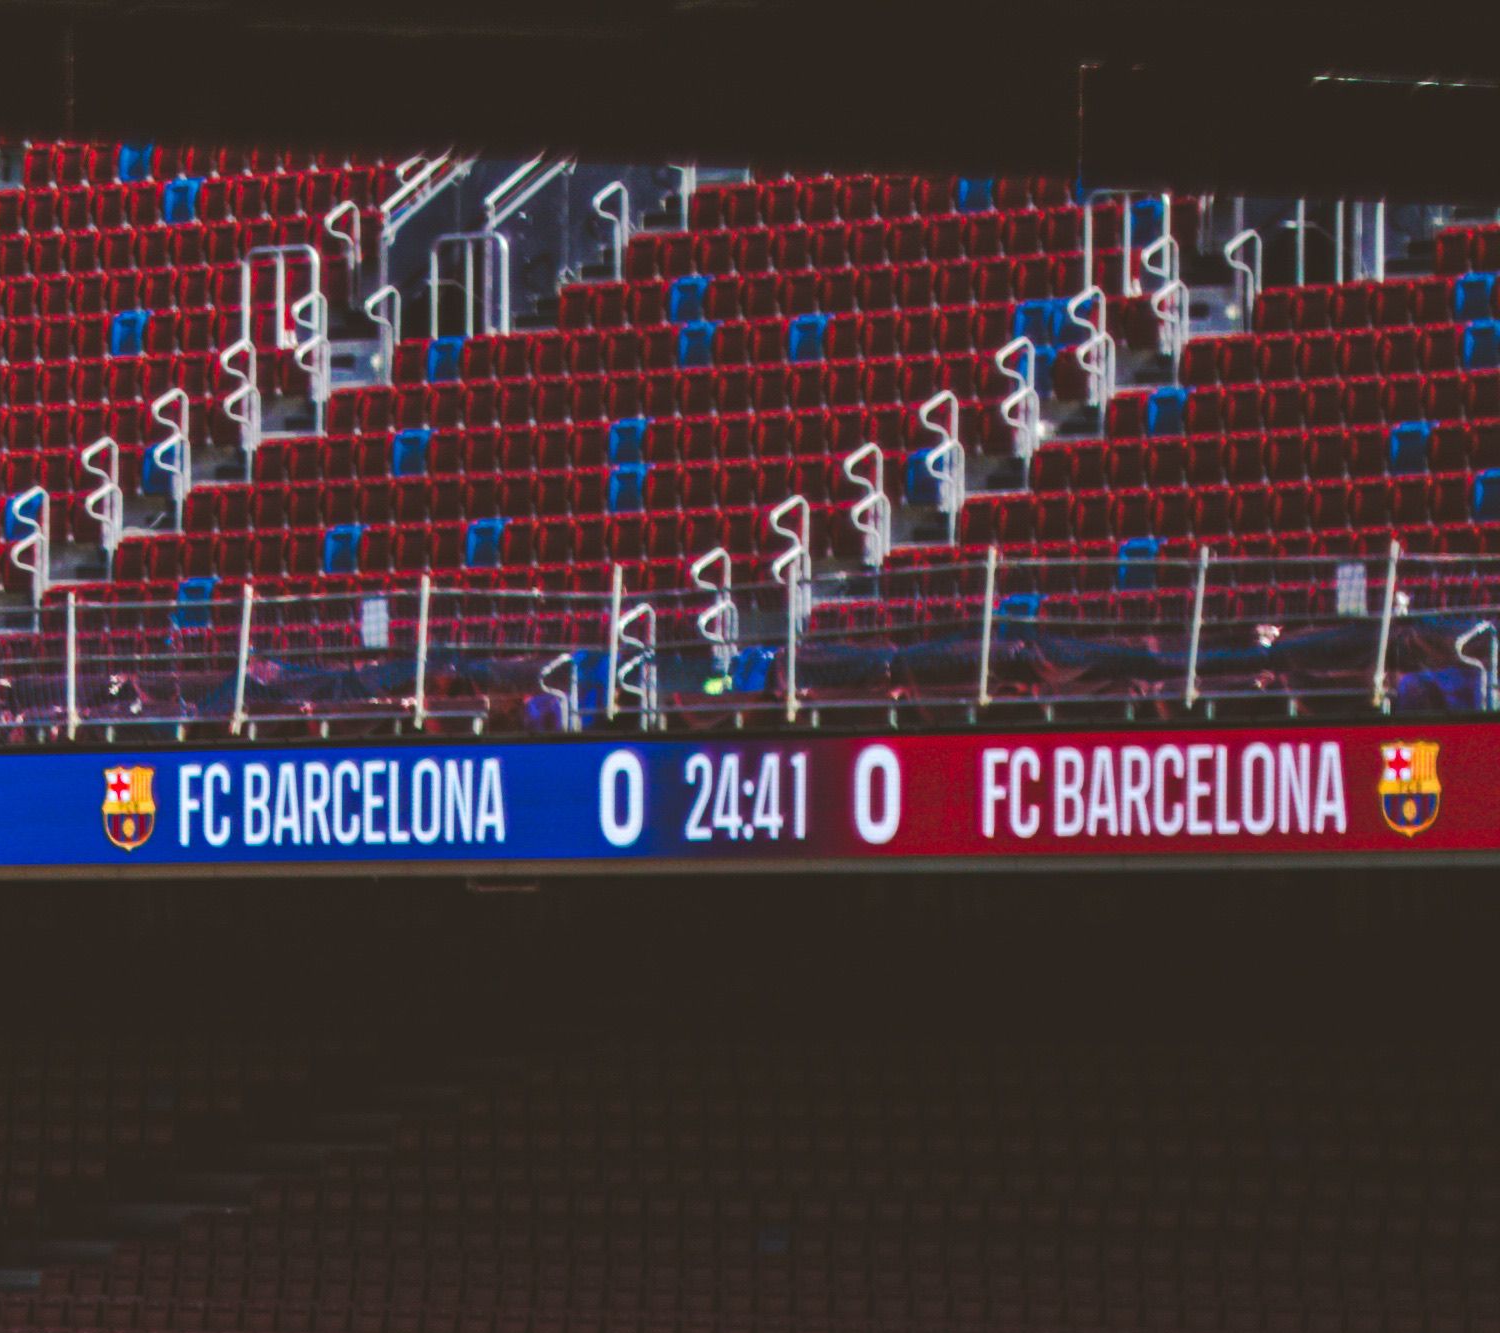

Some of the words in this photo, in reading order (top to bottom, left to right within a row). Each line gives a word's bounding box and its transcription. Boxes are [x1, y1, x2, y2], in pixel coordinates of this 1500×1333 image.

[178, 763, 232, 848] FC
[243, 757, 506, 847] BARCELONA
[599, 749, 645, 848] 0
[684, 751, 808, 841] 24:41
[854, 744, 901, 845] 0
[981, 747, 1042, 838] FC
[1054, 741, 1348, 837] BARCELONA
